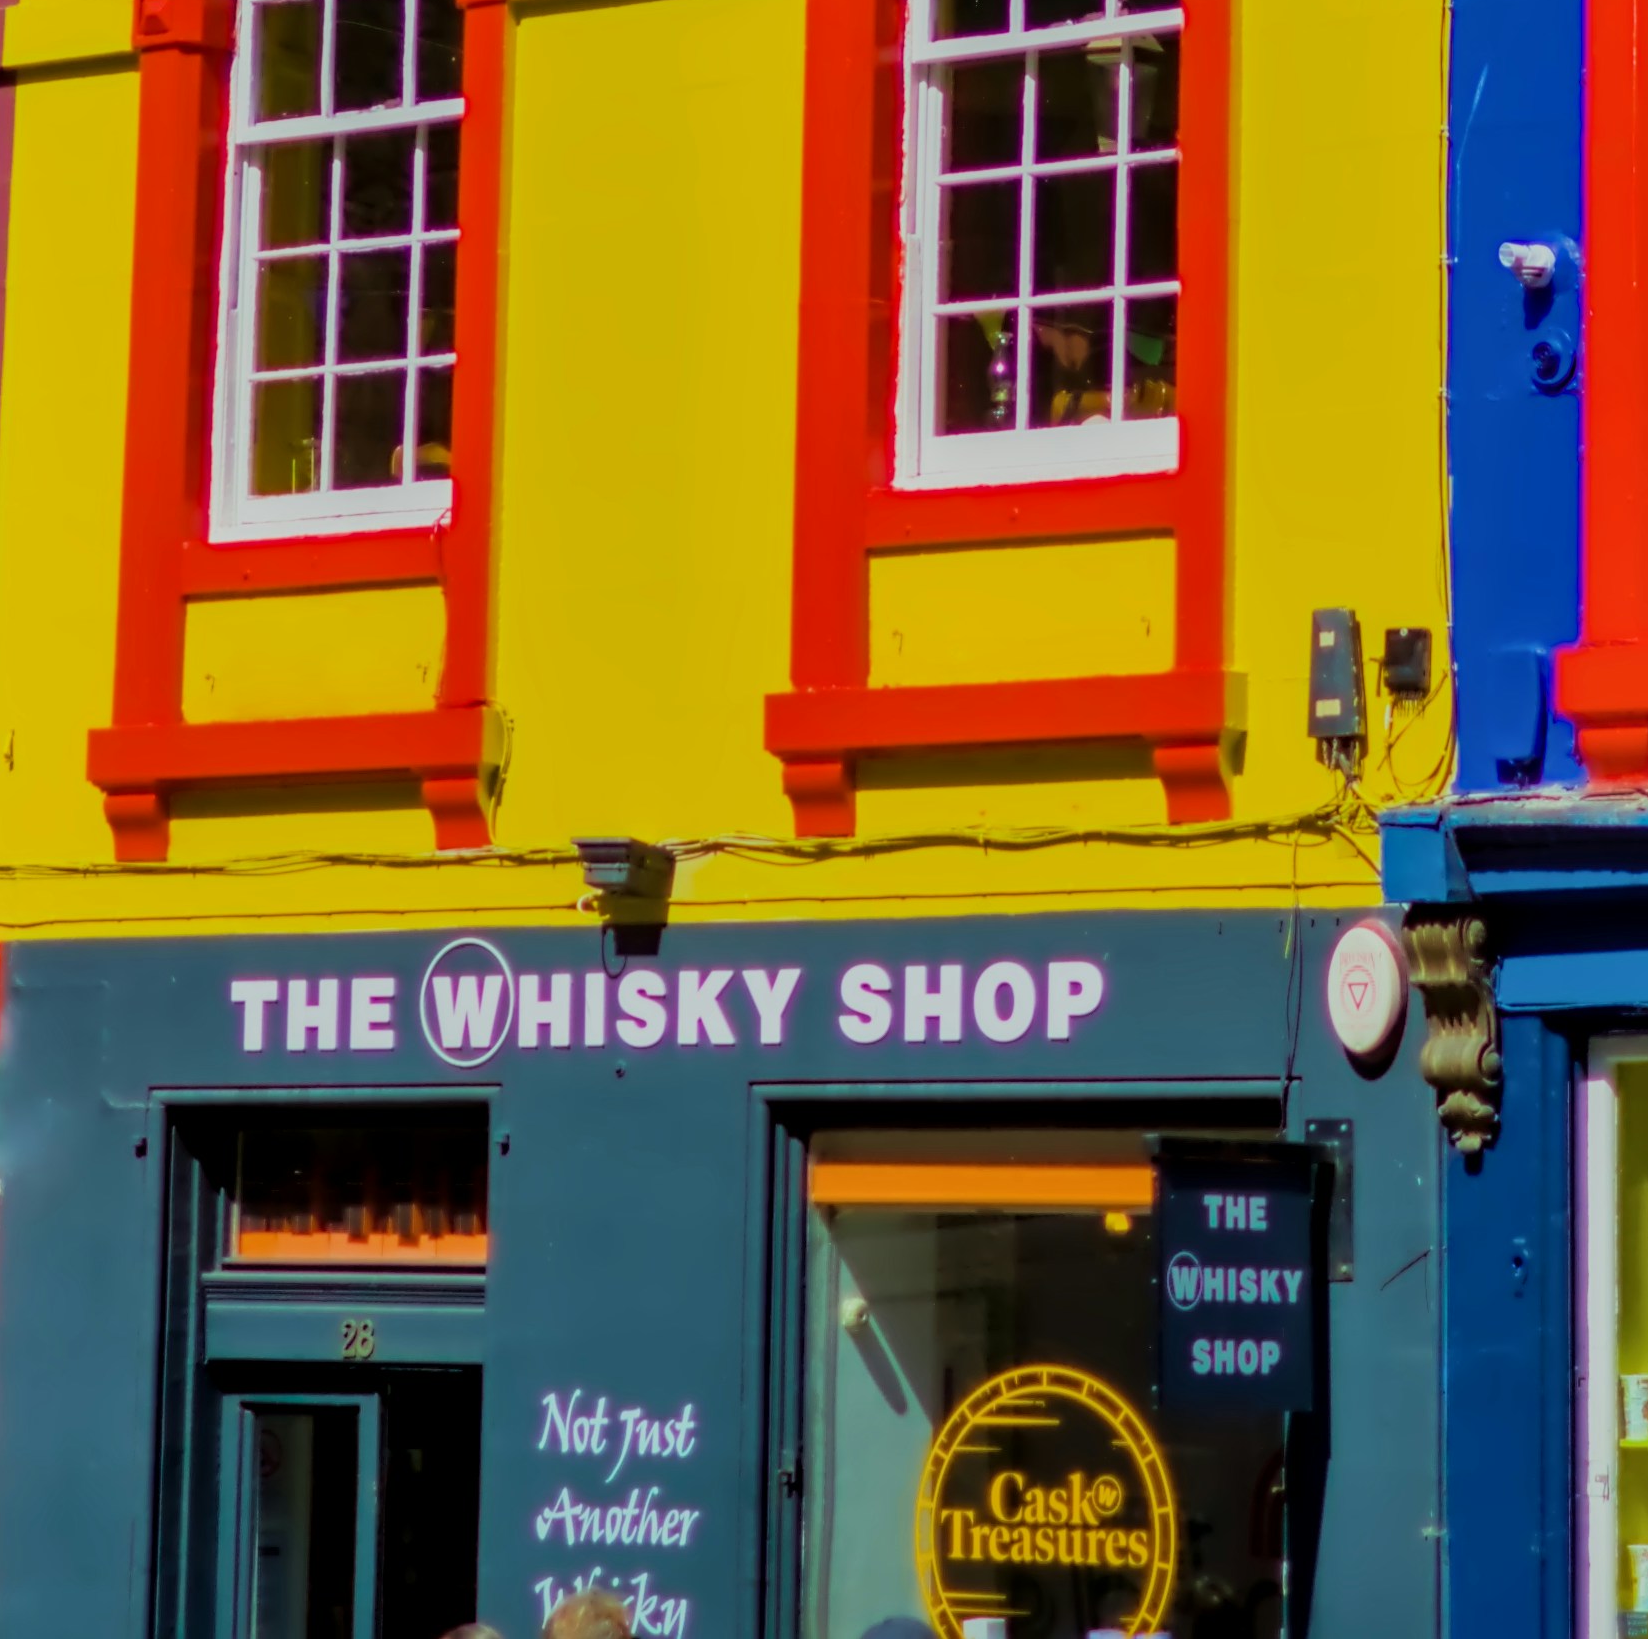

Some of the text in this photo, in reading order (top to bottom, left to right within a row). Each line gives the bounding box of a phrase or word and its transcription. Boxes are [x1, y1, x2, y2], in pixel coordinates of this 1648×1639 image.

[231, 961, 1105, 1053] THE WHISKY SHOP
[1204, 1193, 1268, 1231] THE
[1171, 1264, 1304, 1306] WHISKY
[342, 1319, 375, 1360] 28
[1192, 1339, 1281, 1376] SHOP
[538, 1389, 696, 1484] Not Just
[536, 1485, 700, 1546] Another
[990, 1472, 1099, 1527] Cask
[941, 1509, 1148, 1568] Treasures
